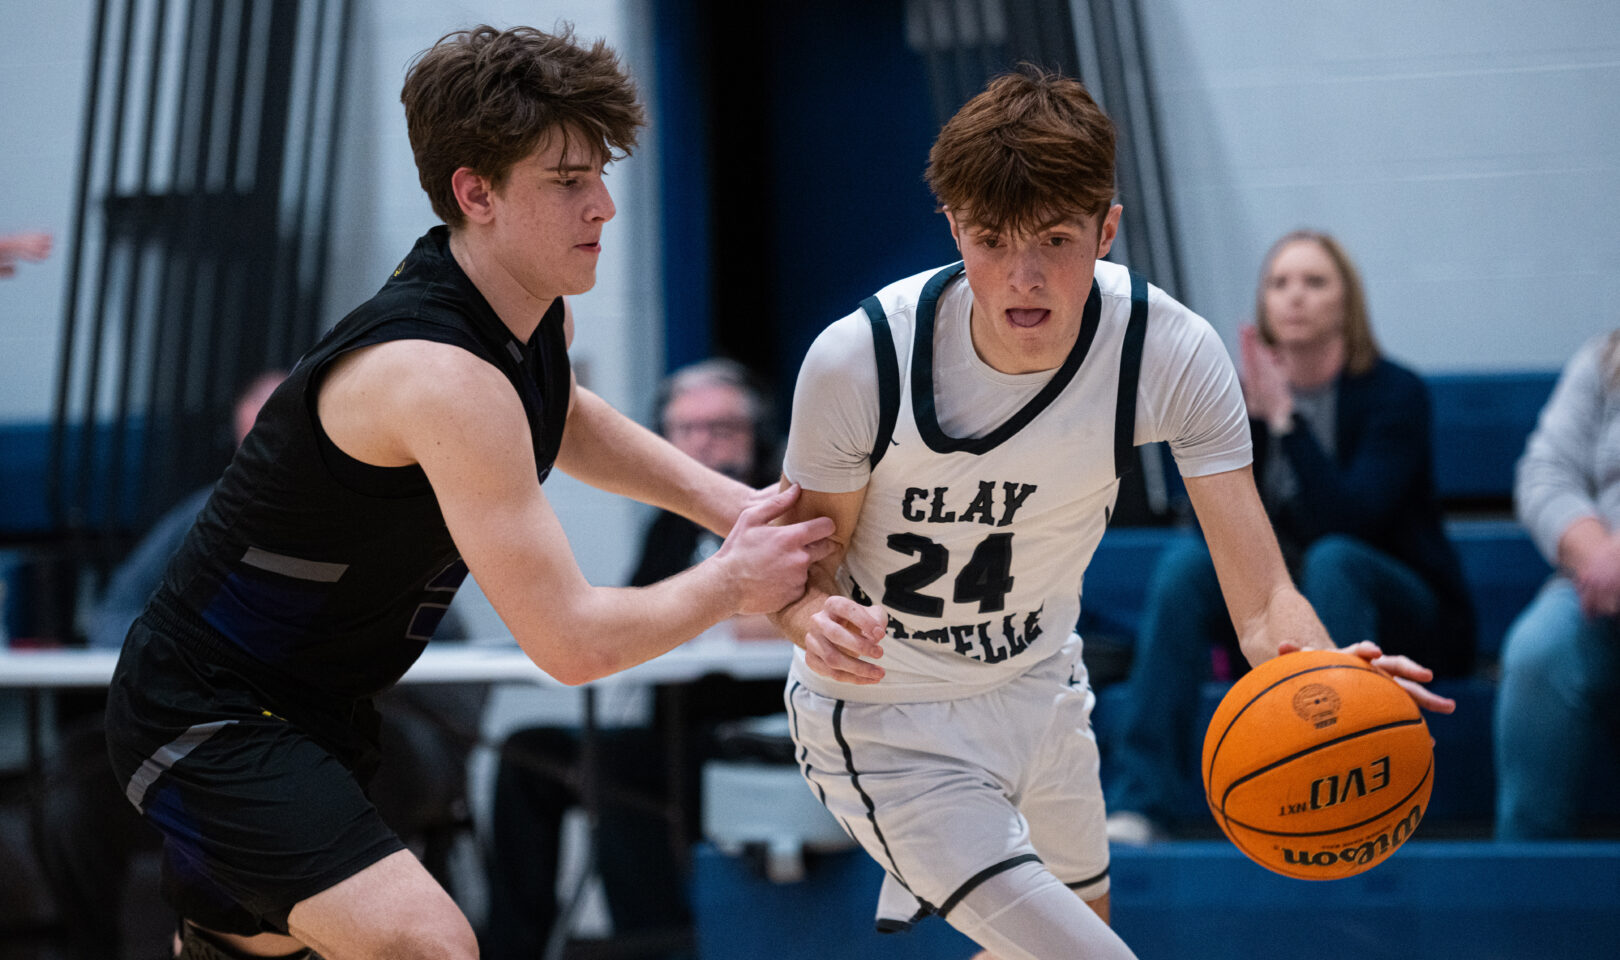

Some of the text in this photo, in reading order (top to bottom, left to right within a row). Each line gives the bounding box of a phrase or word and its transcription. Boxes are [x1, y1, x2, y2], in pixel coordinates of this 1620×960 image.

[902, 480, 1038, 527] CLAY
[881, 531, 1015, 618] 24
[1277, 755, 1391, 817] EVO NXT
[1281, 804, 1421, 867] Wilson
